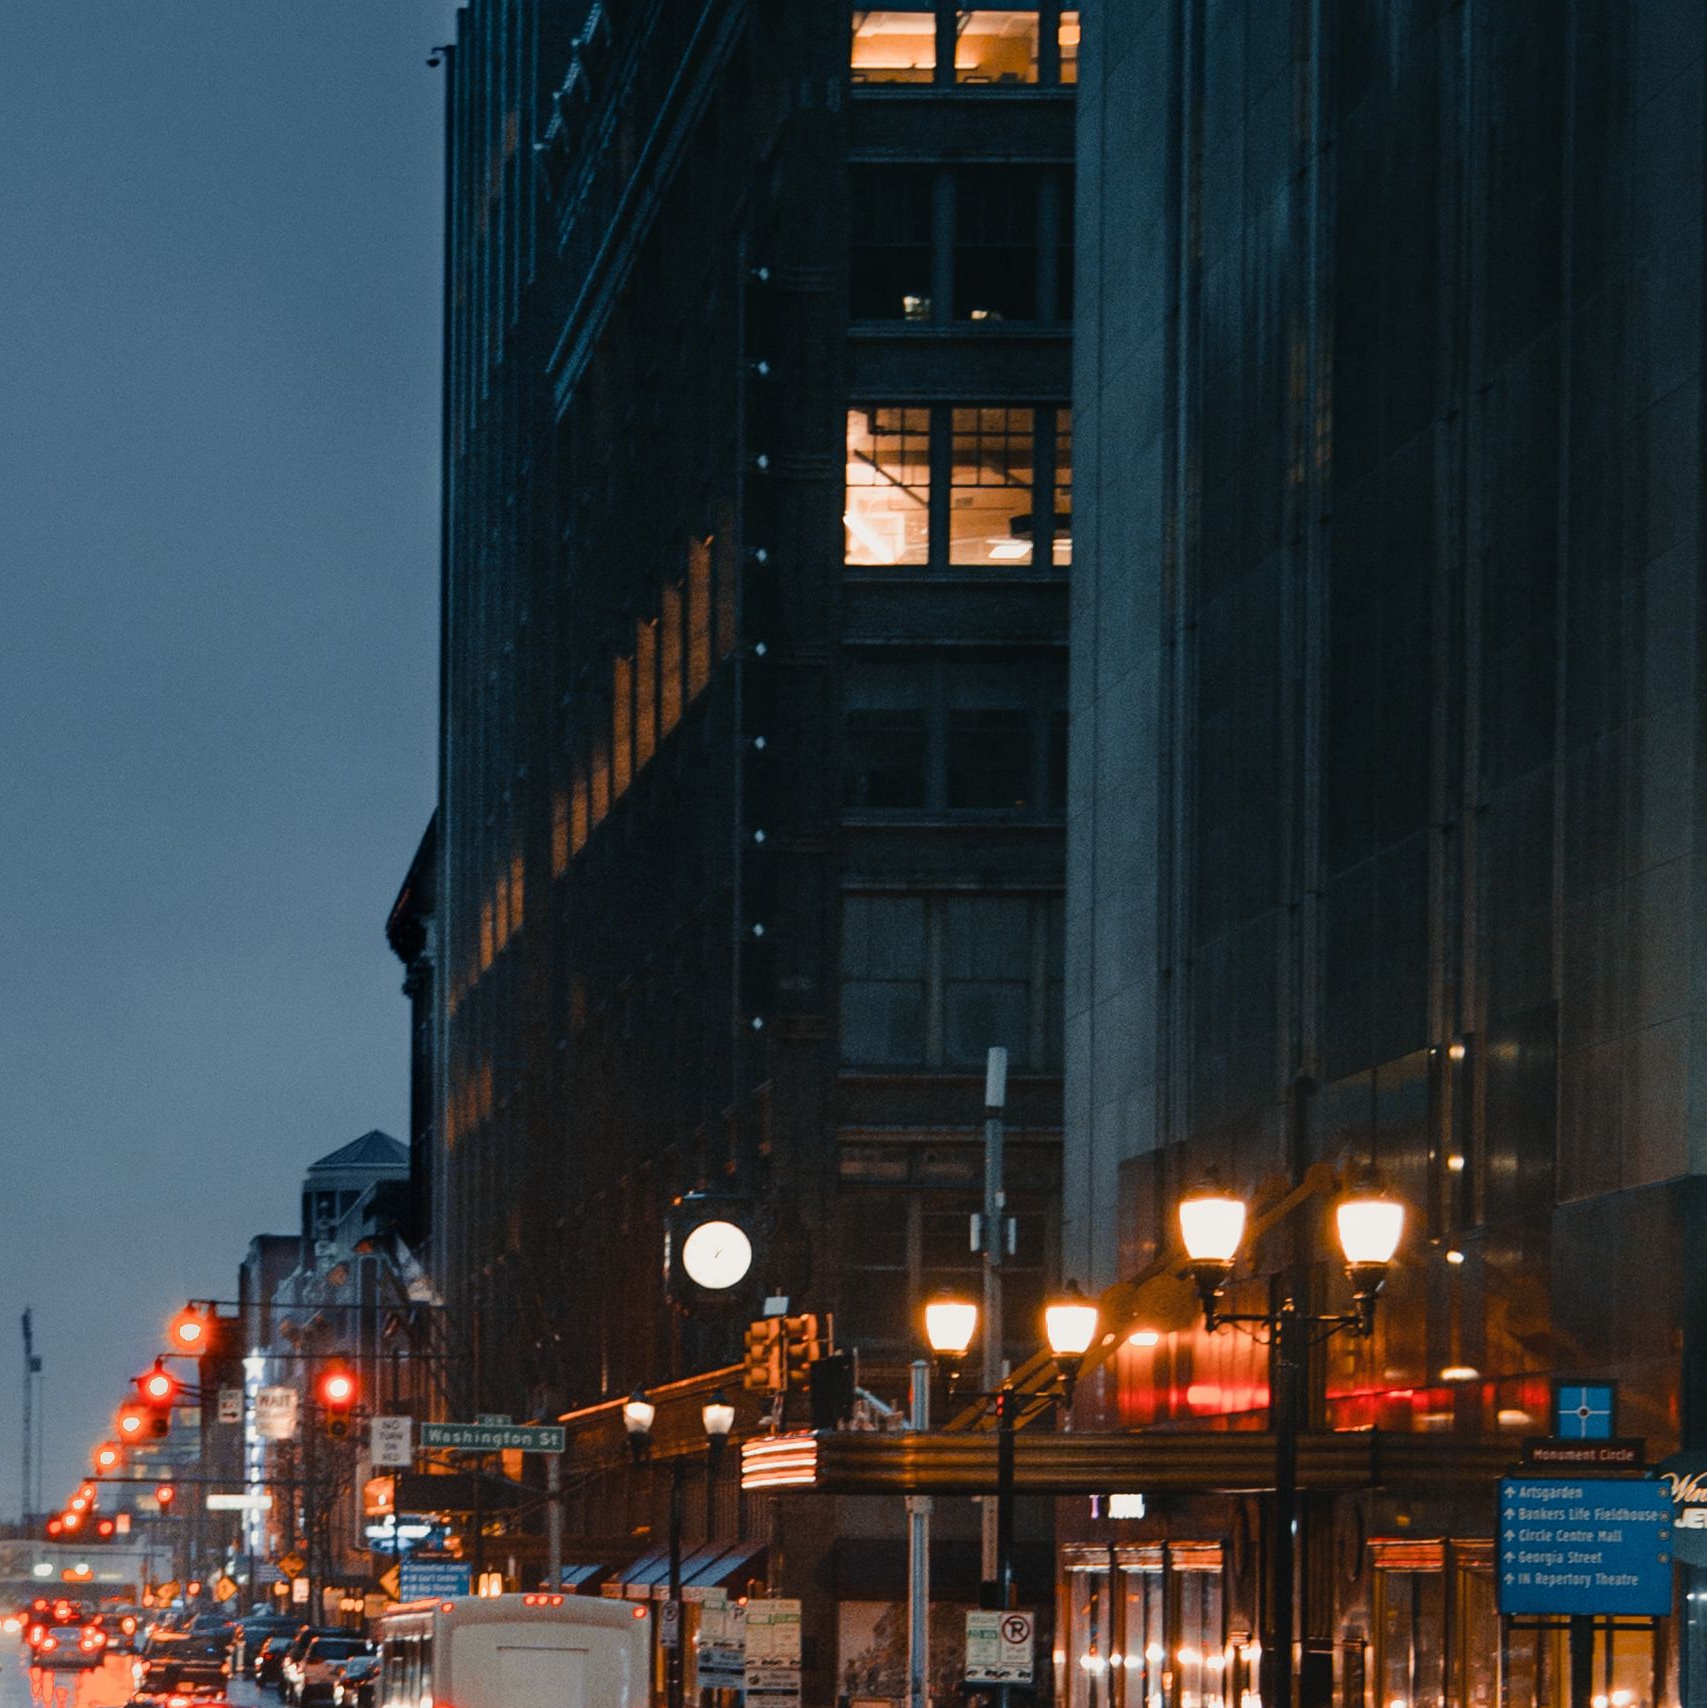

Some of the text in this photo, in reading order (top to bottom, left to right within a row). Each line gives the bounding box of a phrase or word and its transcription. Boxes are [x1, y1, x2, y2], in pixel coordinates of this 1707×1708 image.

[429, 1430, 559, 1448] Washington St
[1533, 1449, 1635, 1461] Monument Circle
[1518, 1486, 1583, 1501] Artsgarden
[1518, 1508, 1658, 1521] Bankers Life Fieldhouse
[1674, 1508, 1707, 1529] JE
[1518, 1529, 1623, 1543] Circle Centre Mall
[1518, 1551, 1602, 1566] Georgia Street
[1518, 1573, 1639, 1588] IN Repertory Theatre
